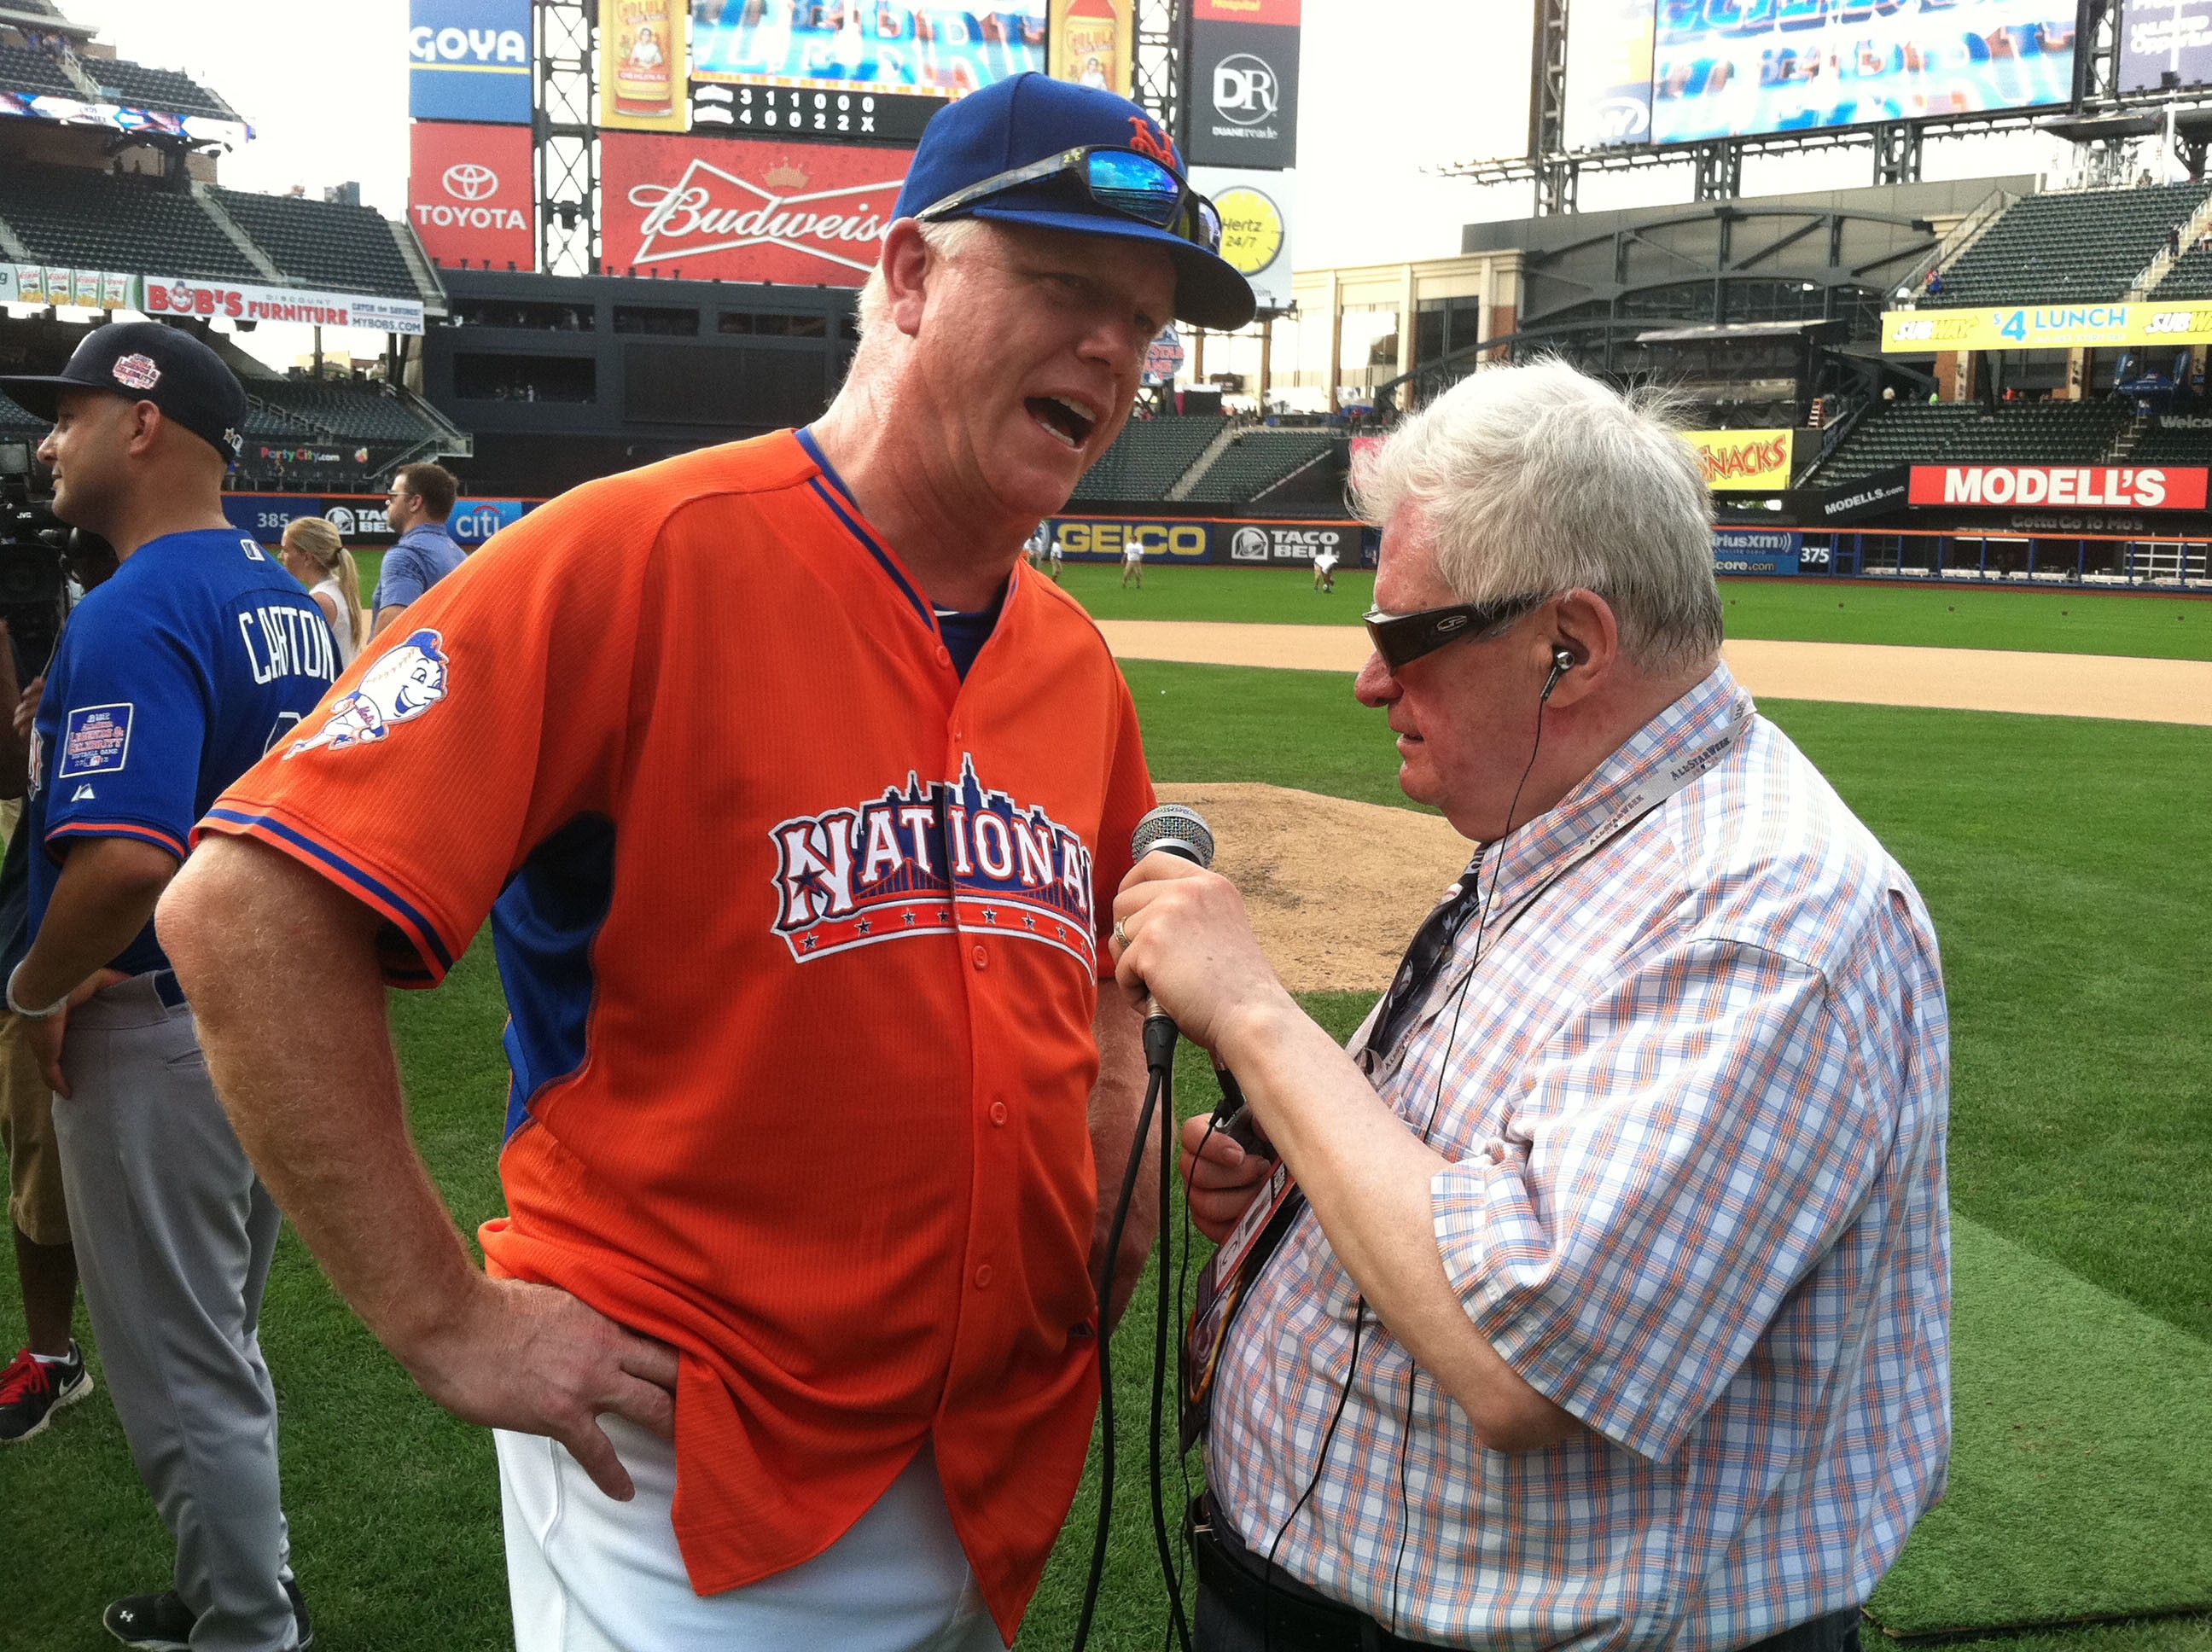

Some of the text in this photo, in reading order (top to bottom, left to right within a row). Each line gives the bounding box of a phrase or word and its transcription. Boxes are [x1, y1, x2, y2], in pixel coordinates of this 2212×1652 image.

[410, 26, 526, 62] GOYA
[740, 88, 875, 113] 3 1 1 0 0 0
[740, 108, 875, 132] 4 0 0 2 2 X
[415, 204, 528, 230] TOYOTA
[628, 183, 894, 242] Budweis
[1222, 218, 1263, 233] Hertz
[1225, 236, 1257, 249] 24/7
[148, 282, 243, 317] BOB'S
[248, 300, 348, 326] FURNITURE
[352, 317, 422, 333] MYBOBS.COM
[2035, 307, 2126, 329] LUNCH
[2144, 311, 2212, 334] SUBWA
[1892, 317, 1979, 341] SUBWAY
[1944, 467, 2167, 507] MODELL'S
[1825, 486, 1906, 515] MODELLS.com
[258, 513, 289, 528] 385
[456, 509, 500, 538] citi
[1057, 522, 1206, 556] GEICO
[1271, 529, 1340, 545] TACO
[1274, 544, 1339, 559] BELL
[1800, 547, 1830, 563] 375
[1714, 561, 1775, 572] core.com
[238, 606, 335, 684] CARTON
[781, 805, 1094, 928] NATIONA
